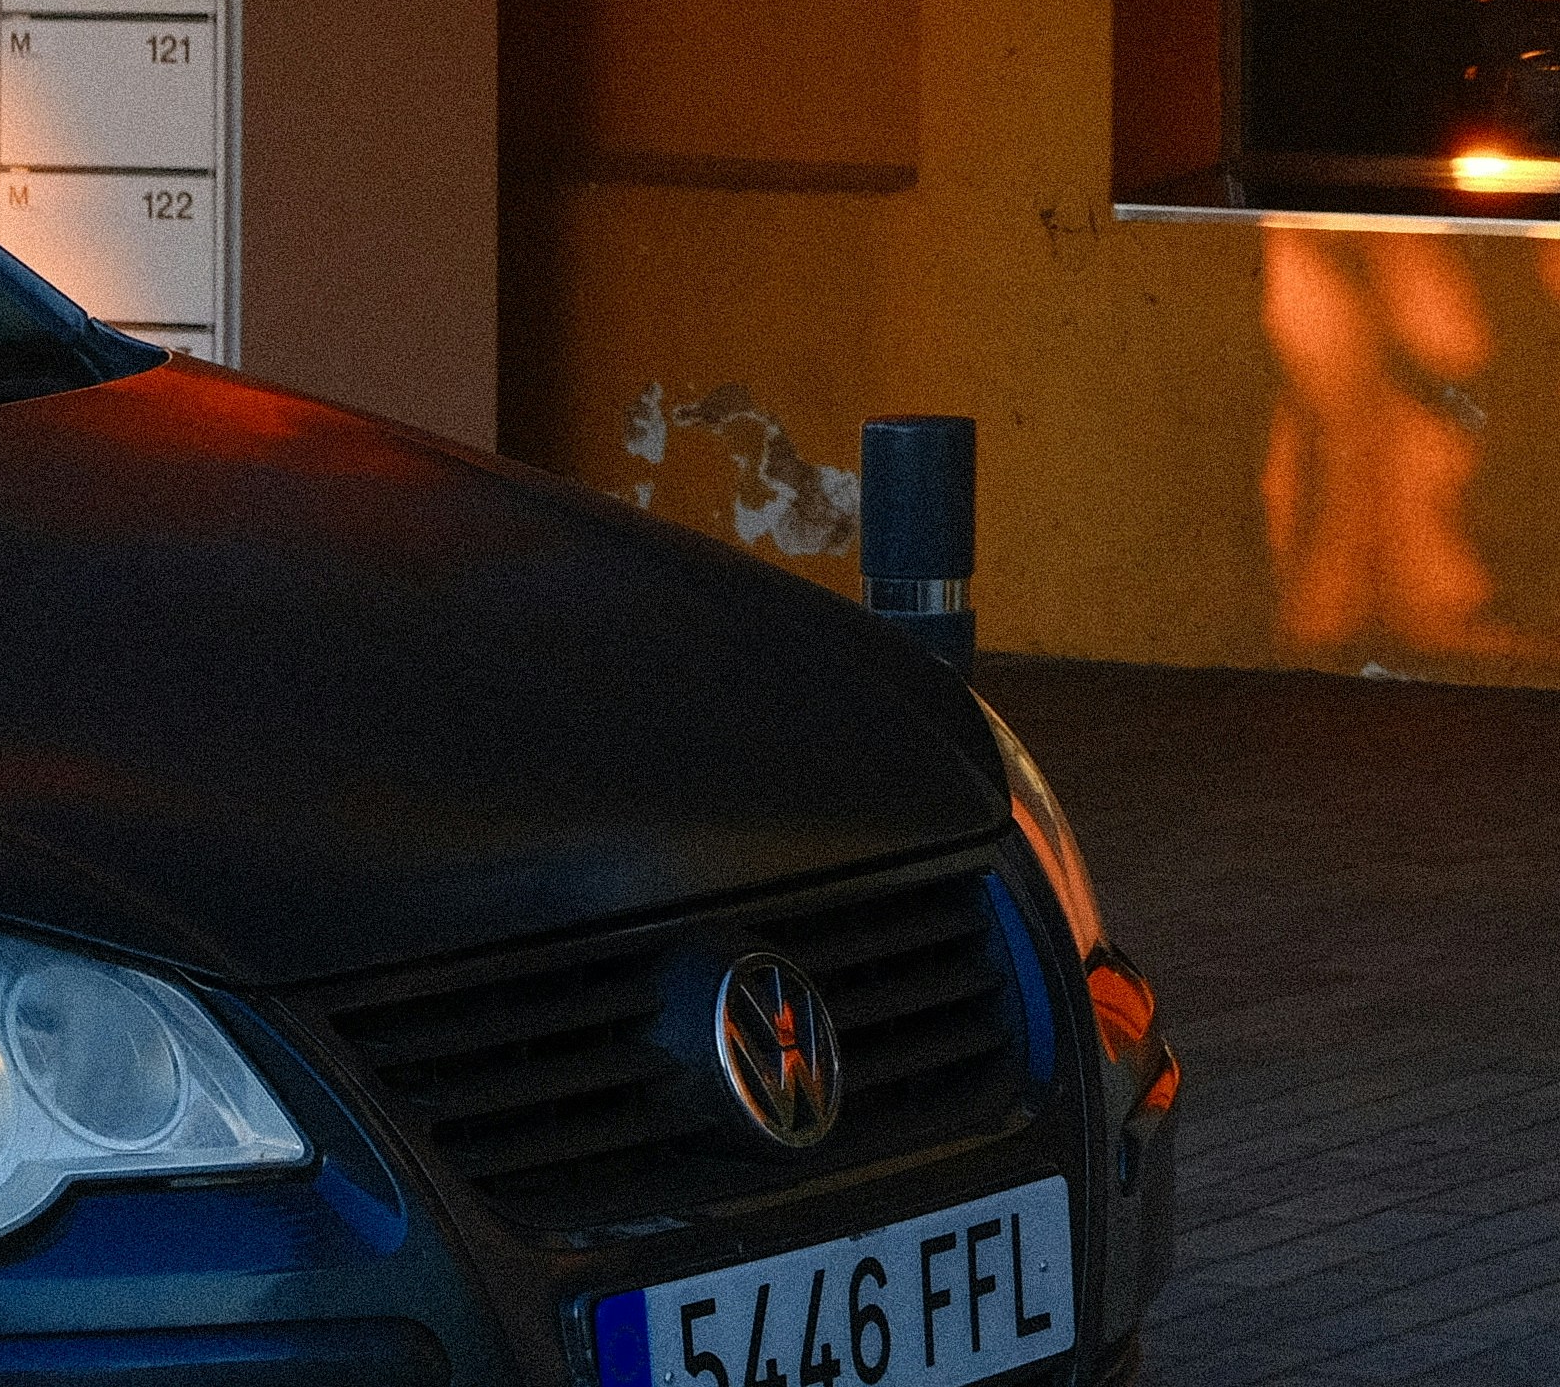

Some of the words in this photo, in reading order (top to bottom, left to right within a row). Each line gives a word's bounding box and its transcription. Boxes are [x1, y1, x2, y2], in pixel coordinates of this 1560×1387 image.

[10, 33, 31, 55] M
[146, 35, 191, 64] 121
[9, 186, 29, 207] M
[142, 192, 193, 220] 122
[680, 1257, 891, 1387] 5446
[919, 1213, 1052, 1367] FFL
